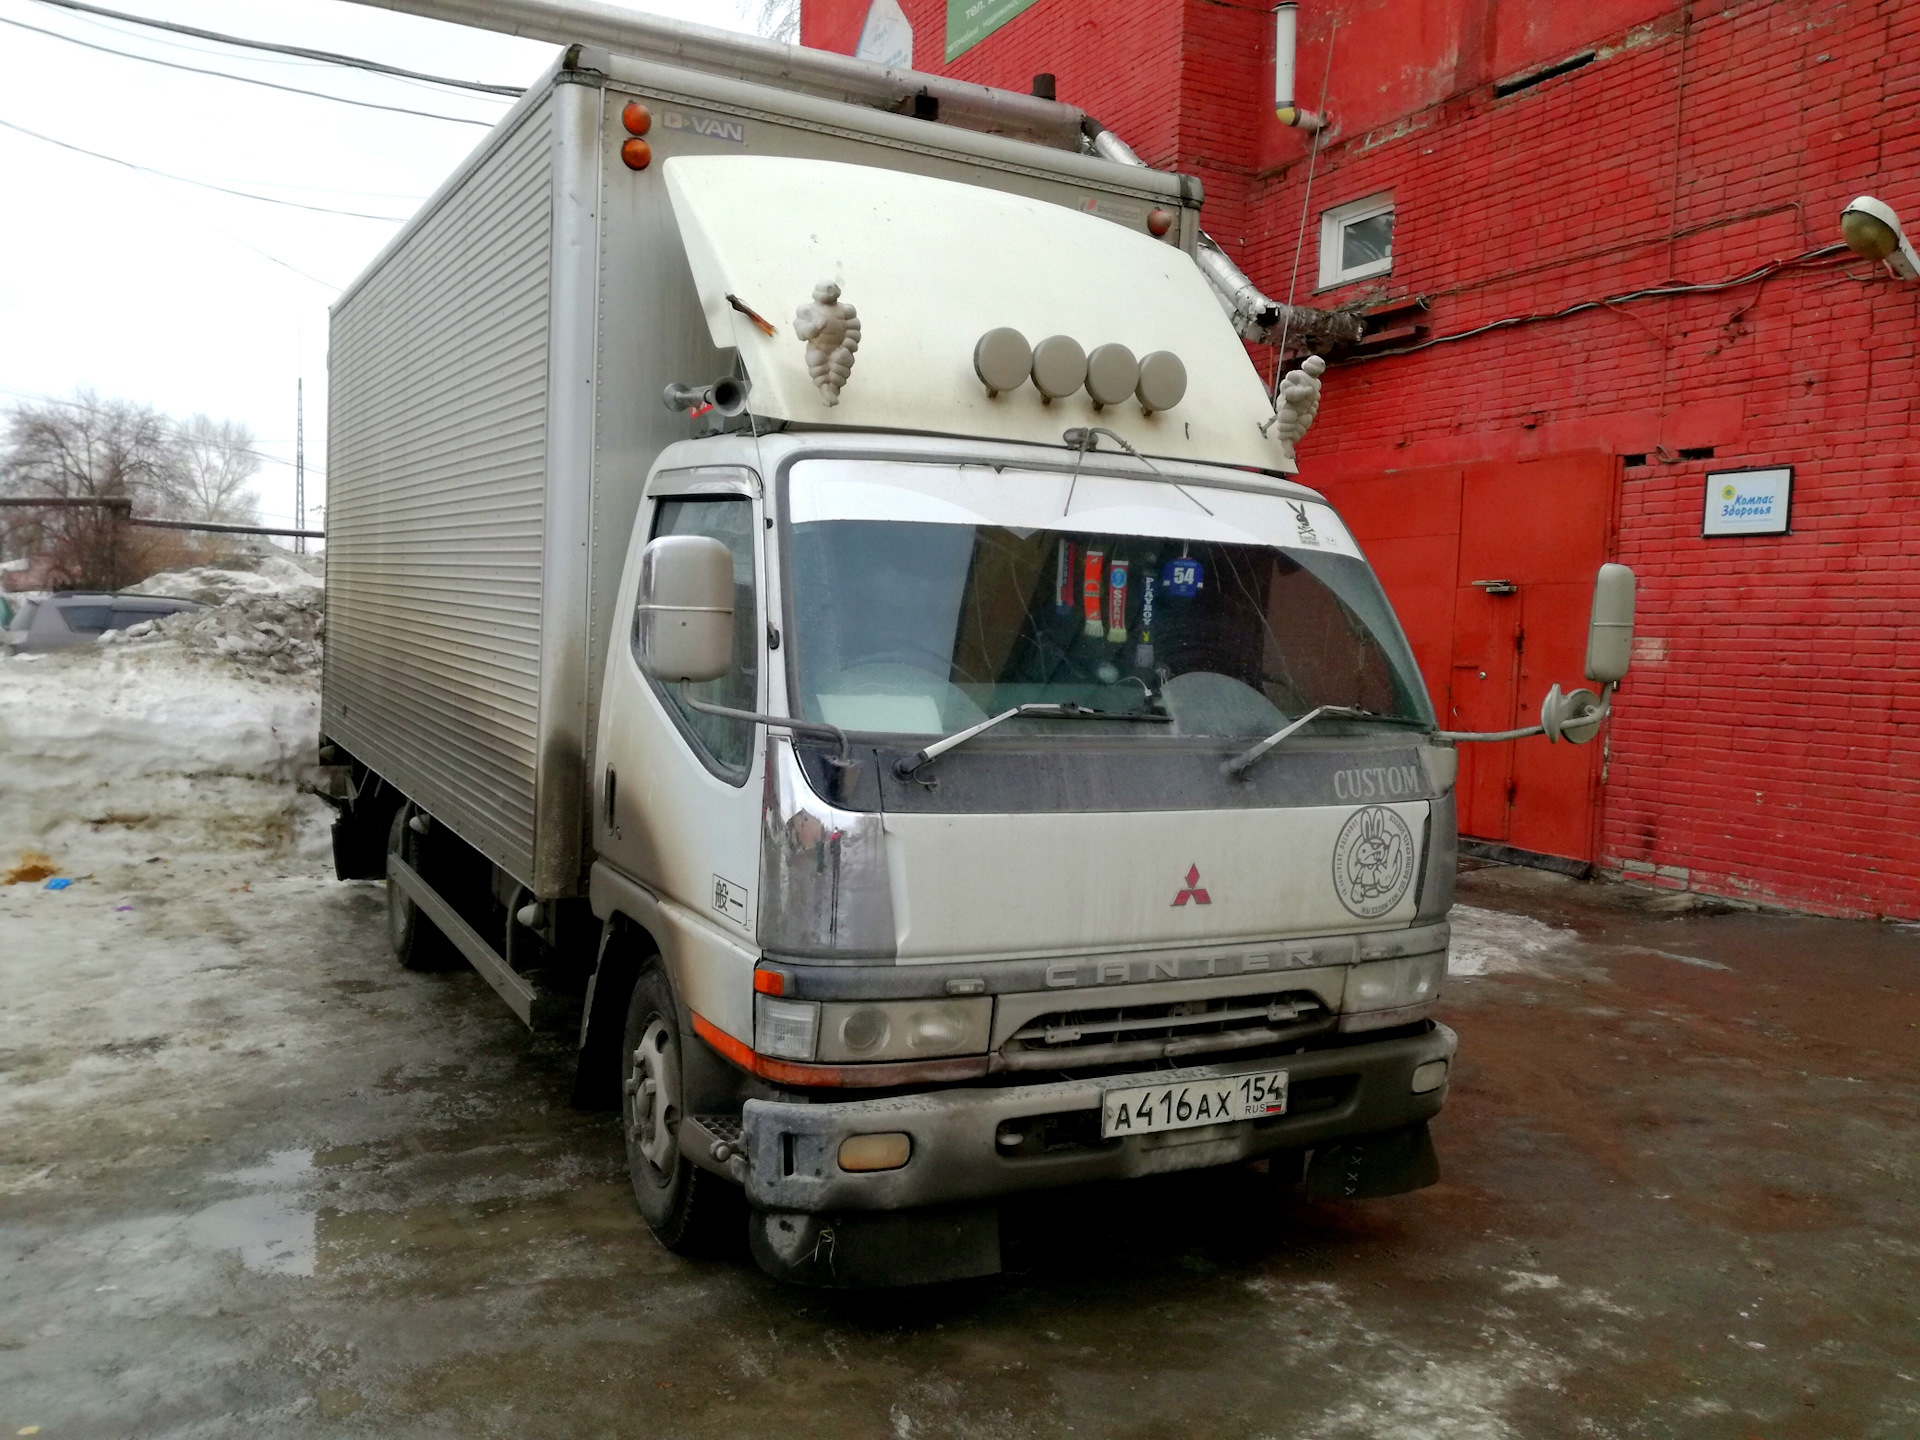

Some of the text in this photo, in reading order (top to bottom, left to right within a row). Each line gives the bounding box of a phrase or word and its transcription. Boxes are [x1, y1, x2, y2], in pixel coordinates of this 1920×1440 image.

[1721, 505, 1771, 518] Здоровья
[1734, 494, 1774, 506] Компас
[1173, 567, 1195, 585] 54
[1143, 577, 1155, 626] PLAYBOY
[1334, 766, 1420, 799] CUSTOM
[1046, 947, 1315, 987] CANTER
[1240, 1075, 1280, 1104] 154
[1245, 1105, 1266, 1114] RUS
